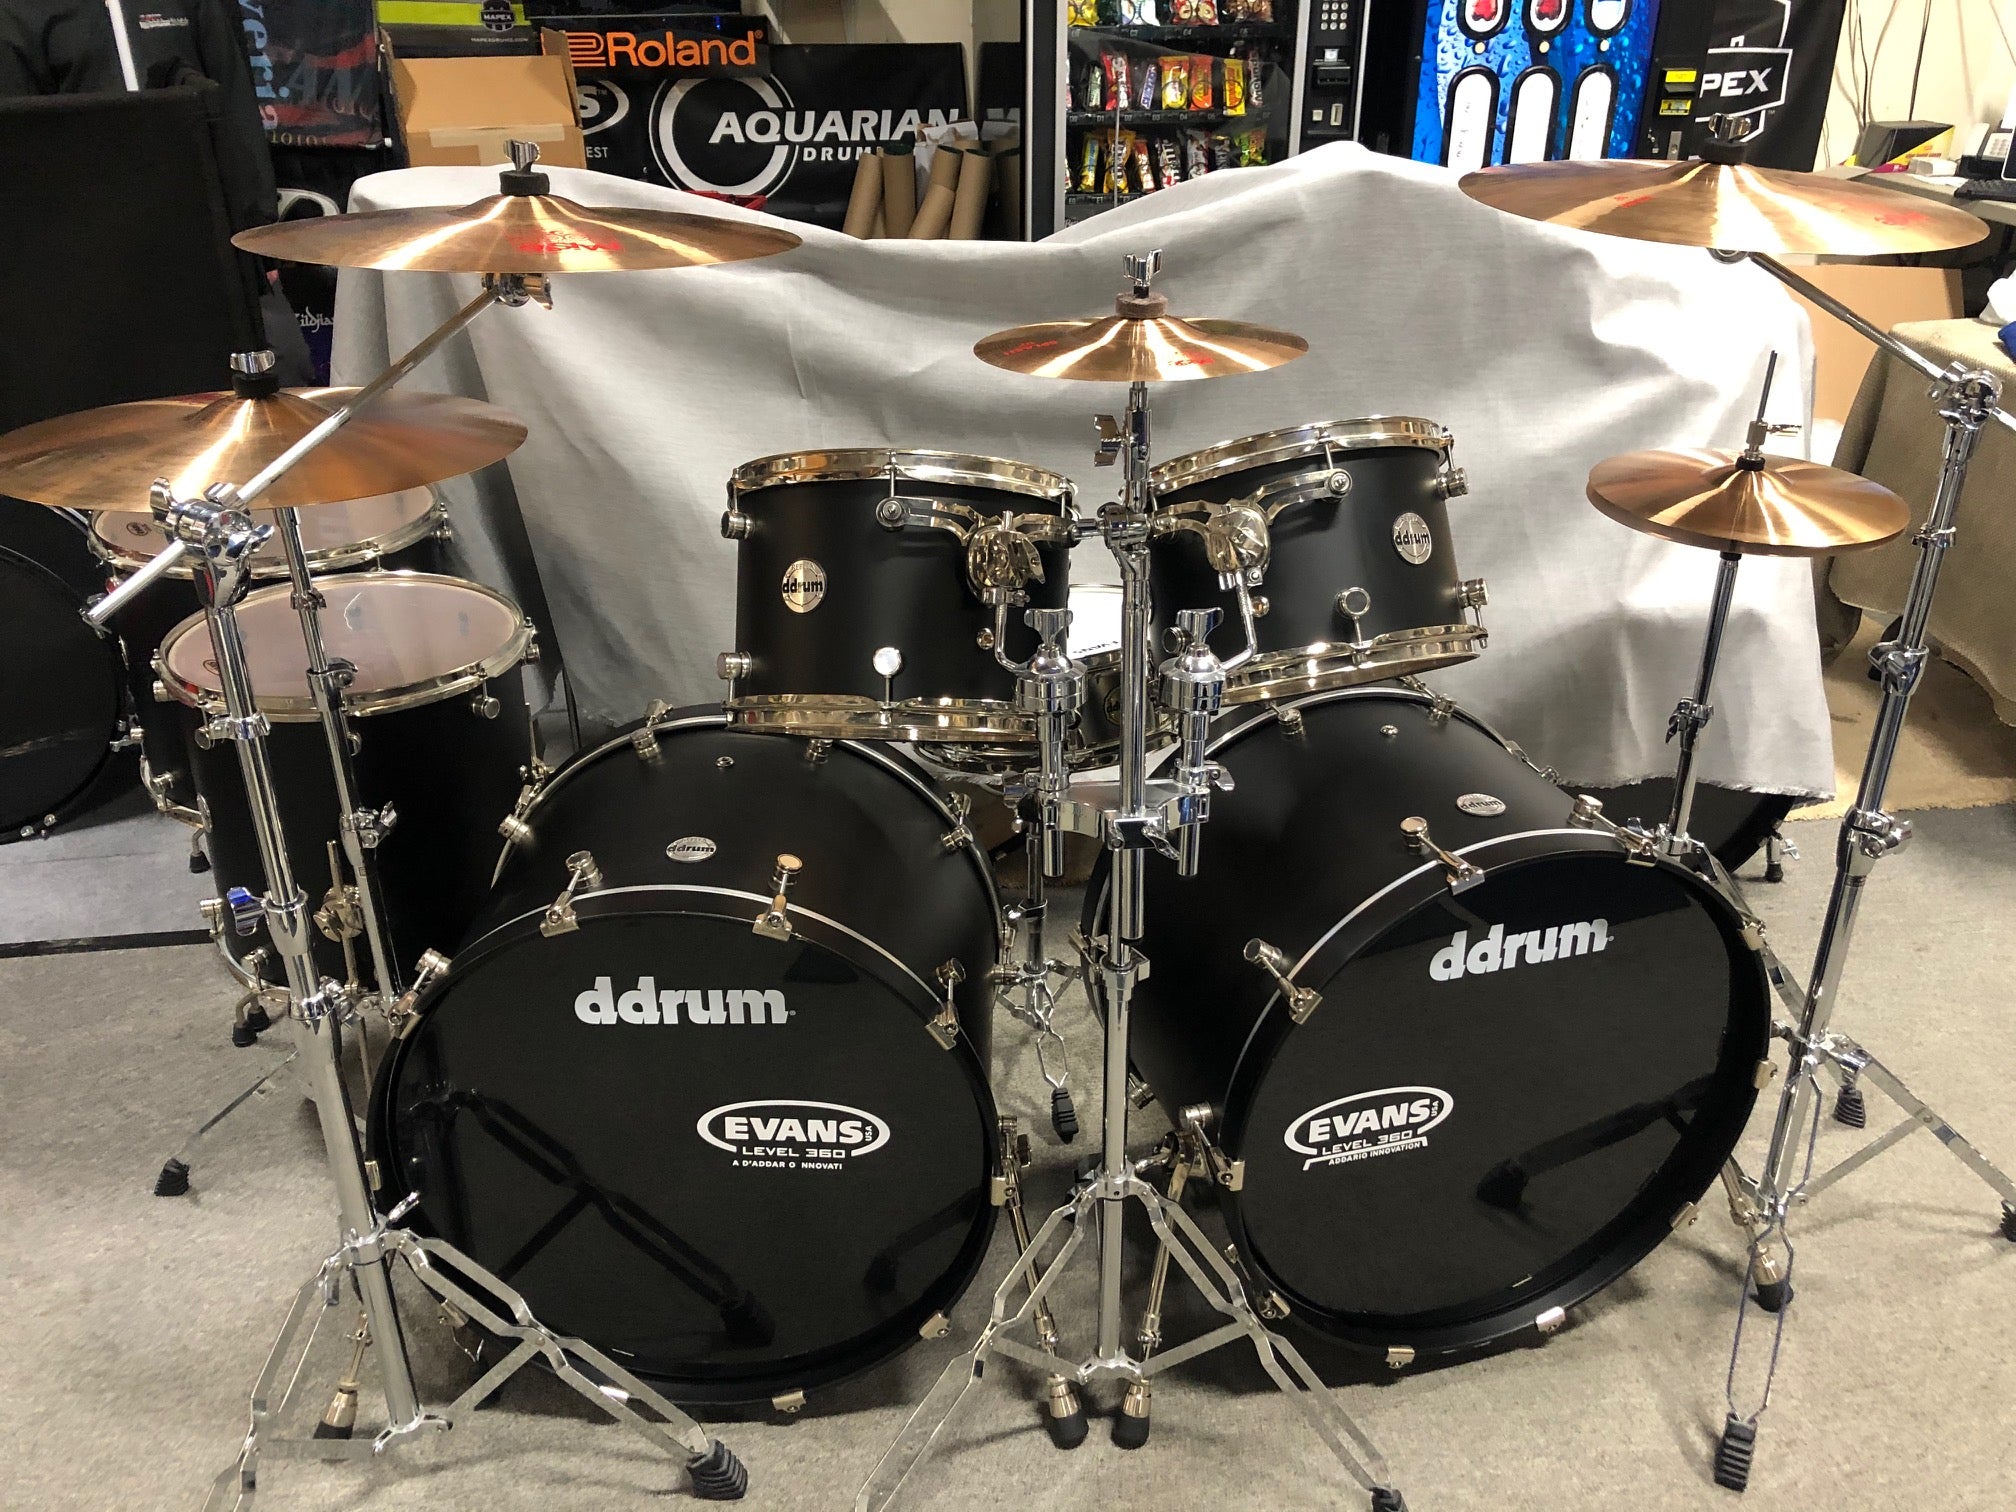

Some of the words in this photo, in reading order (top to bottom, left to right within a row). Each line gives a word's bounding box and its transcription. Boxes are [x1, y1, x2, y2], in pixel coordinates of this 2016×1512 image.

[606, 31, 756, 67] Roland
[803, 146, 881, 161] DRUM
[295, 306, 334, 333] ildjia
[1394, 530, 1430, 546] ddrum
[782, 577, 823, 593] ddrum
[1461, 800, 1502, 810] ddrum
[668, 844, 715, 853] ddrum
[1429, 918, 1609, 982] ddrum
[574, 976, 789, 1025] ddrum
[724, 1116, 864, 1144] EVANS
[864, 1125, 873, 1142] USA
[1308, 1098, 1431, 1144] EVANS
[742, 1146, 800, 1158] LEVEL
[805, 1148, 846, 1159] 360
[1322, 1138, 1372, 1156] LEVEL
[1377, 1129, 1413, 1145] 360
[1328, 1152, 1368, 1166] ADDARIO
[1369, 1141, 1421, 1158] INNOVATION
